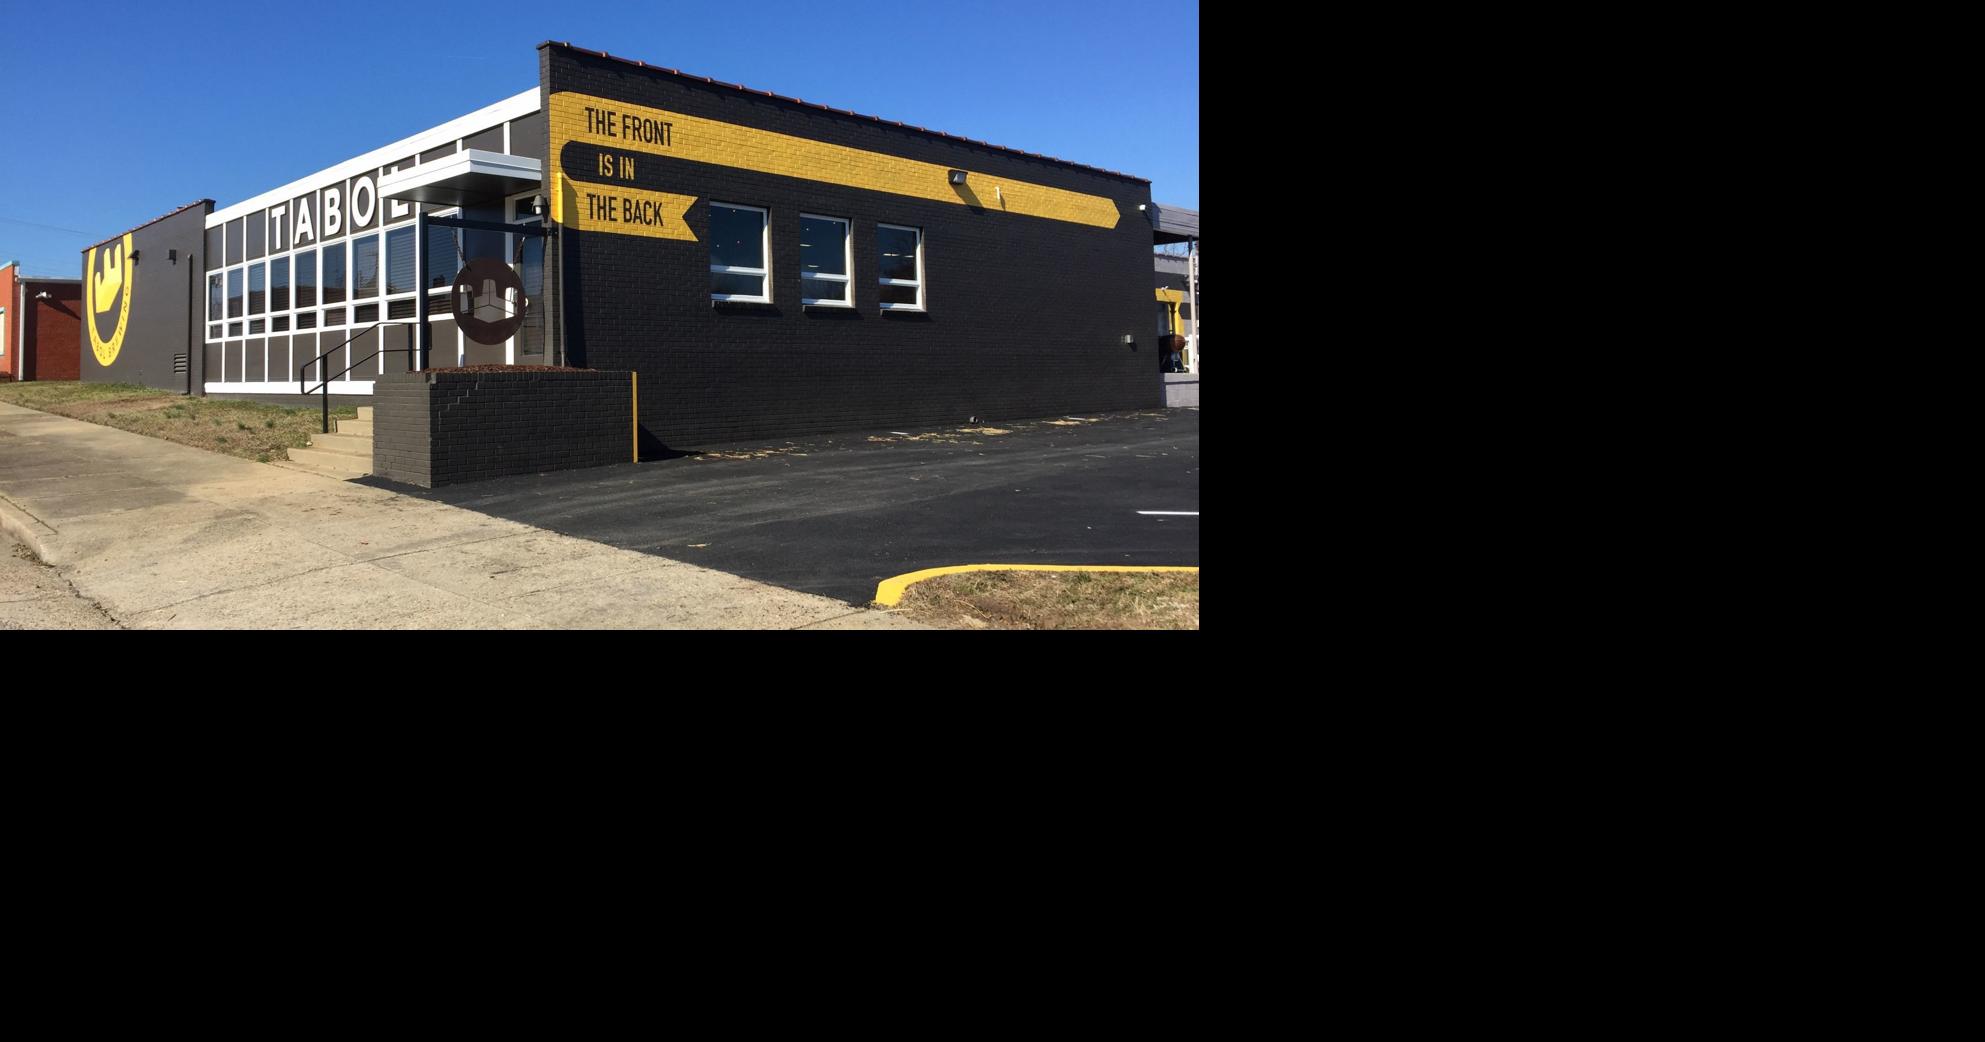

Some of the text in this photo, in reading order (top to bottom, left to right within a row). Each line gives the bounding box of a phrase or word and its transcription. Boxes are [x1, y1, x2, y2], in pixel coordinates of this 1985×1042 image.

[585, 107, 673, 147] THE FRONT
[599, 153, 635, 180] IS IN
[586, 193, 664, 227] THE BACK
